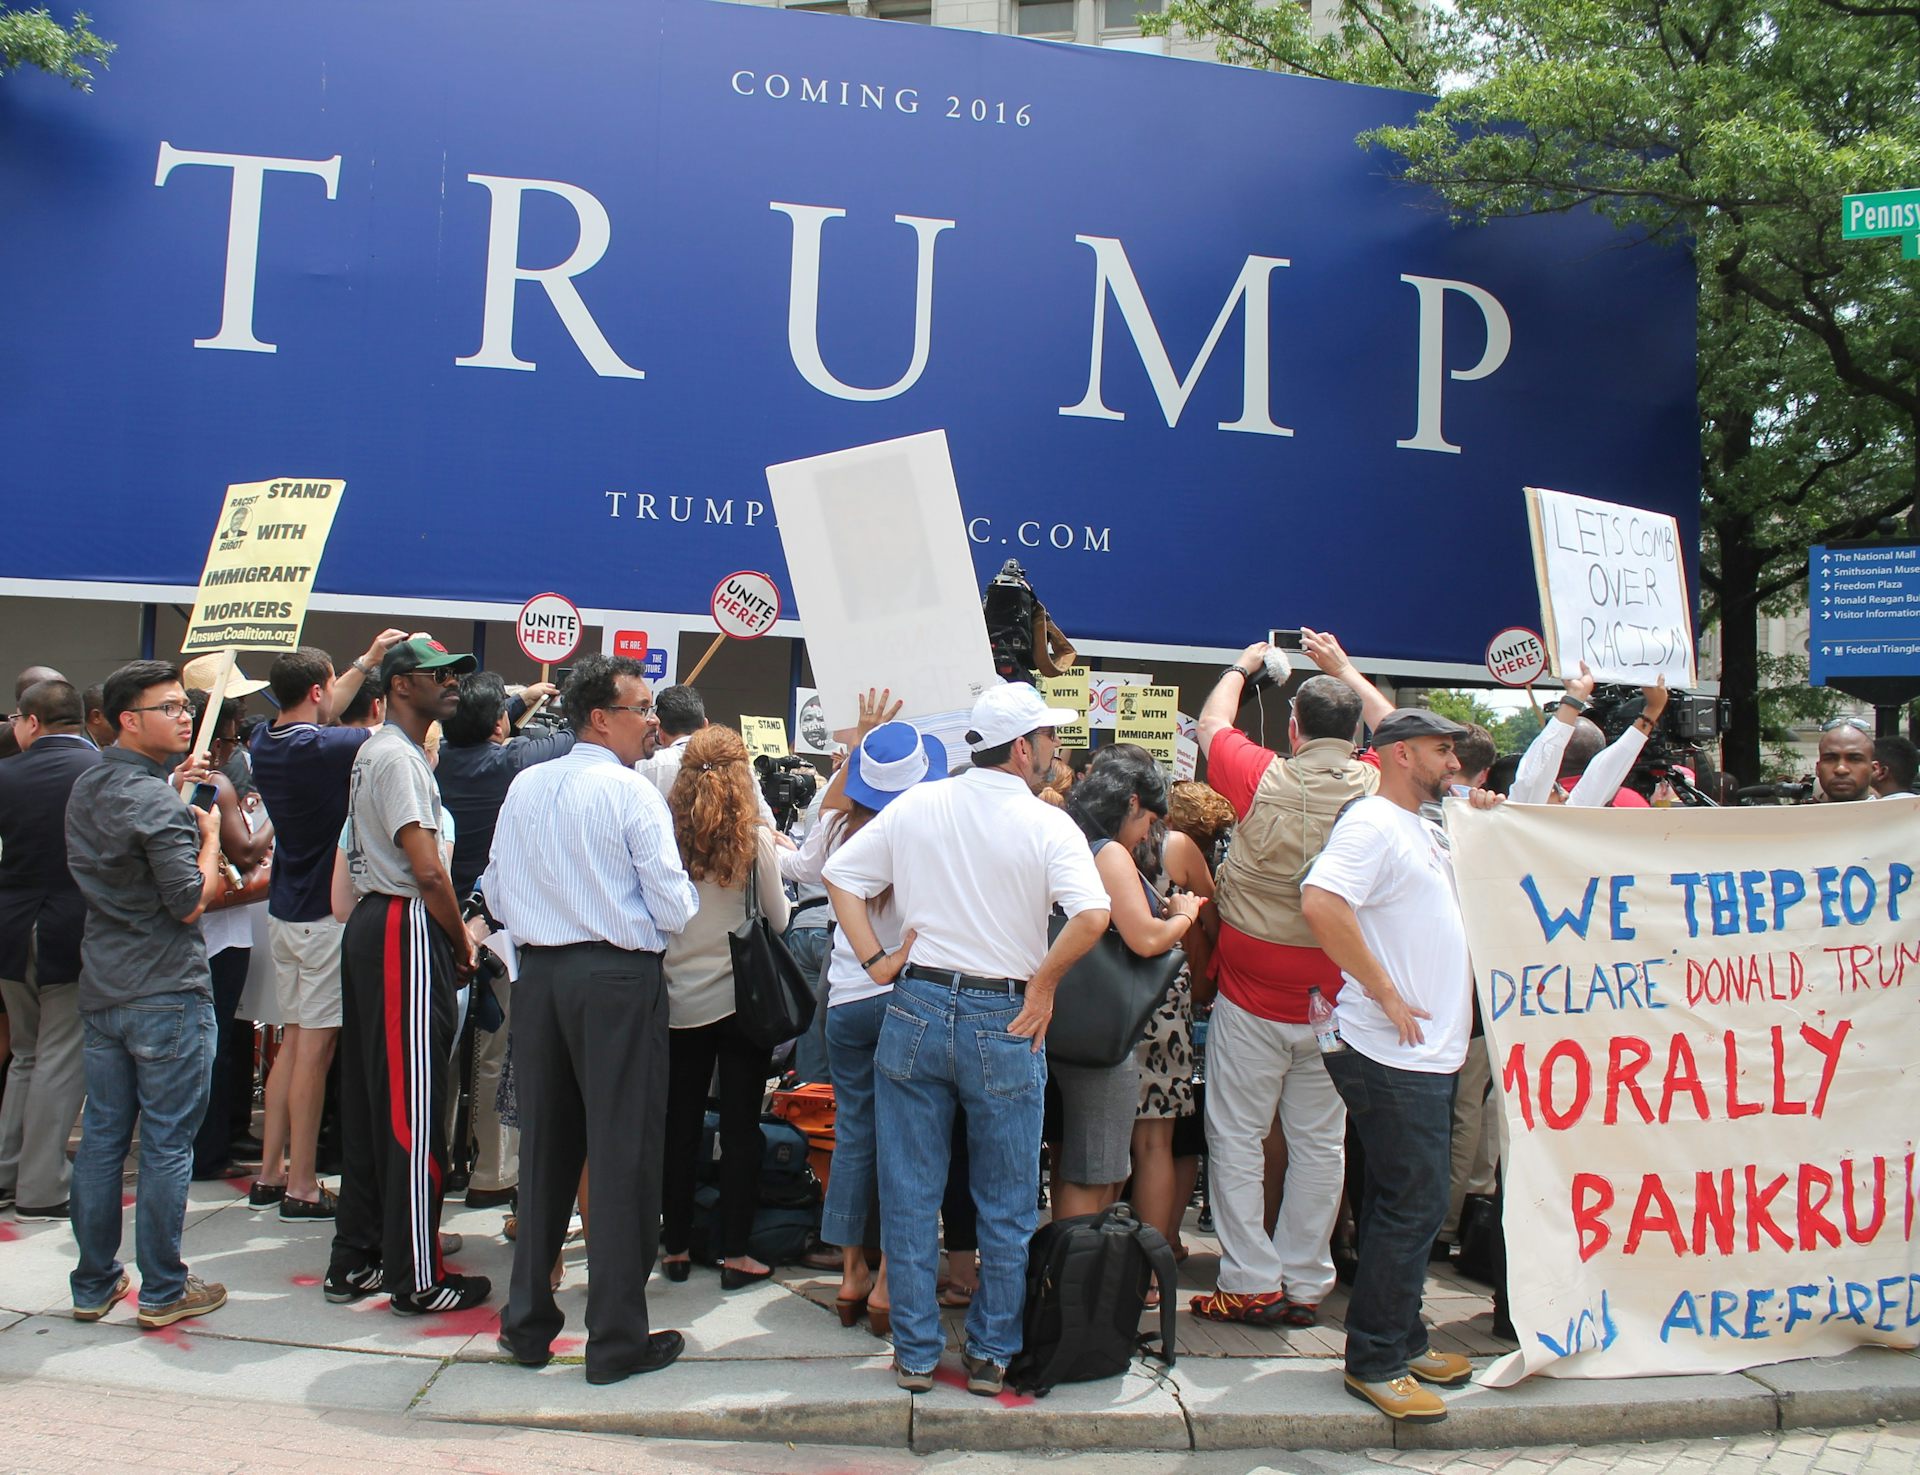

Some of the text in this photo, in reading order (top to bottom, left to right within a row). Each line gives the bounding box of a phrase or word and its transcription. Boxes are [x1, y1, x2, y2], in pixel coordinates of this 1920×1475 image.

[731, 70, 1032, 127] COMING 2016
[154, 140, 1512, 455] TRUMP
[267, 482, 332, 499] STAND
[230, 495, 260, 507] RACIST
[256, 523, 307, 540] WITH
[219, 540, 244, 551] BIGOT
[1629, 517, 1675, 562] COMB
[1834, 550, 1916, 562] The National Mall
[205, 566, 311, 587] IMMIGRANT
[1834, 567, 1892, 577] Smithsonian
[1588, 563, 1663, 608] OVER
[1834, 580, 1903, 590] Freedom Plaza
[727, 580, 776, 620] UNITE
[1834, 596, 1867, 605] Ronald
[1869, 595, 1904, 605] Reagan
[203, 601, 293, 621] WORKERS
[716, 592, 766, 632] HERE!
[1834, 610, 1864, 619] Visitor
[525, 612, 576, 630] UNITE
[189, 626, 296, 643] AnswerCoalition.org
[523, 628, 574, 647] HERE!
[620, 640, 629, 649] WE
[1580, 616, 1687, 669] RACISM
[1491, 637, 1539, 663] UNITE
[1846, 645, 1880, 654] Federal
[1882, 643, 1920, 655] Triangle
[652, 653, 663, 663] THE
[1496, 651, 1543, 677] HERE!
[645, 664, 663, 674] UTURE.
[1062, 668, 1085, 676] AND
[1052, 688, 1079, 697] WITH
[1142, 688, 1174, 698] STAND
[1142, 709, 1167, 719] WITH
[757, 719, 781, 730] STAND
[1056, 726, 1083, 734] KERS
[1118, 729, 1174, 740] IMMIGRANT
[762, 743, 781, 753] WITH
[1520, 873, 1637, 943] WE
[1490, 958, 1669, 1021] DECLARE
[1686, 950, 1806, 1008] DONALD
